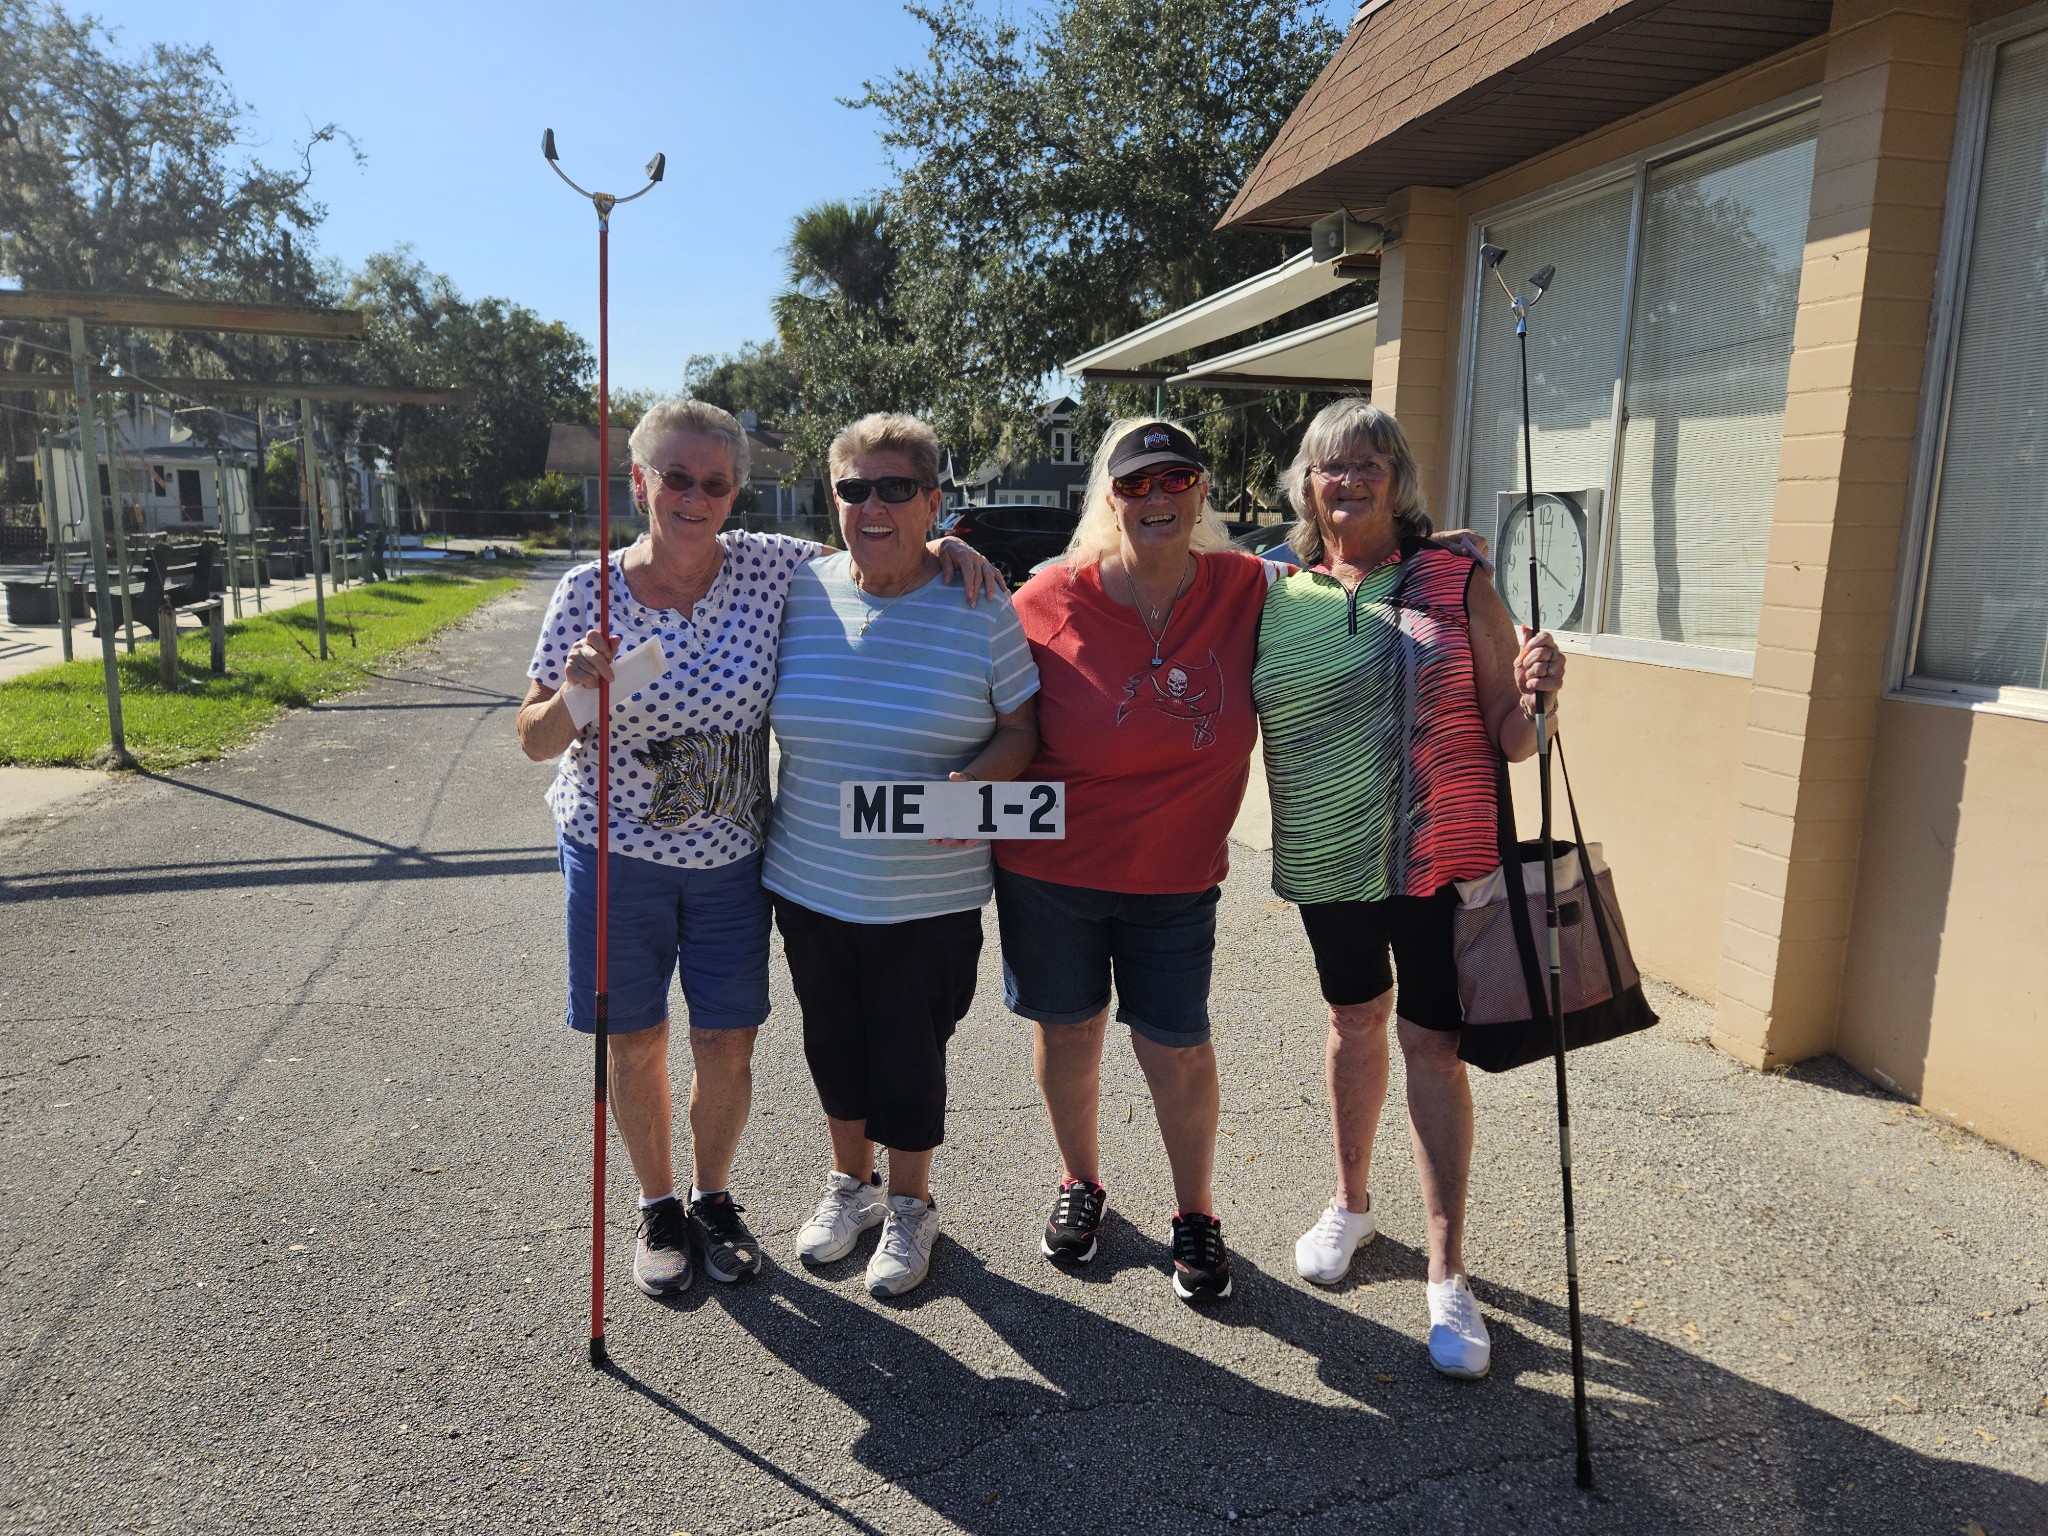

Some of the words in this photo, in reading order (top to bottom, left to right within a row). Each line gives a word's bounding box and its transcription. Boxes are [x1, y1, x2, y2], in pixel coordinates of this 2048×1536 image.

[1539, 504, 1553, 525] 12
[1560, 513, 1564, 528] 1
[1513, 530, 1525, 547] 10
[1571, 531, 1578, 548] 2
[1508, 554, 1516, 573] 9
[1574, 555, 1581, 577] 3
[1512, 581, 1519, 597] 8
[1568, 586, 1576, 601] 4
[1523, 600, 1529, 616] 7
[1539, 604, 1546, 624] 6
[1557, 603, 1563, 619] 5
[853, 785, 925, 833] ME
[977, 784, 1057, 833] 1-2
